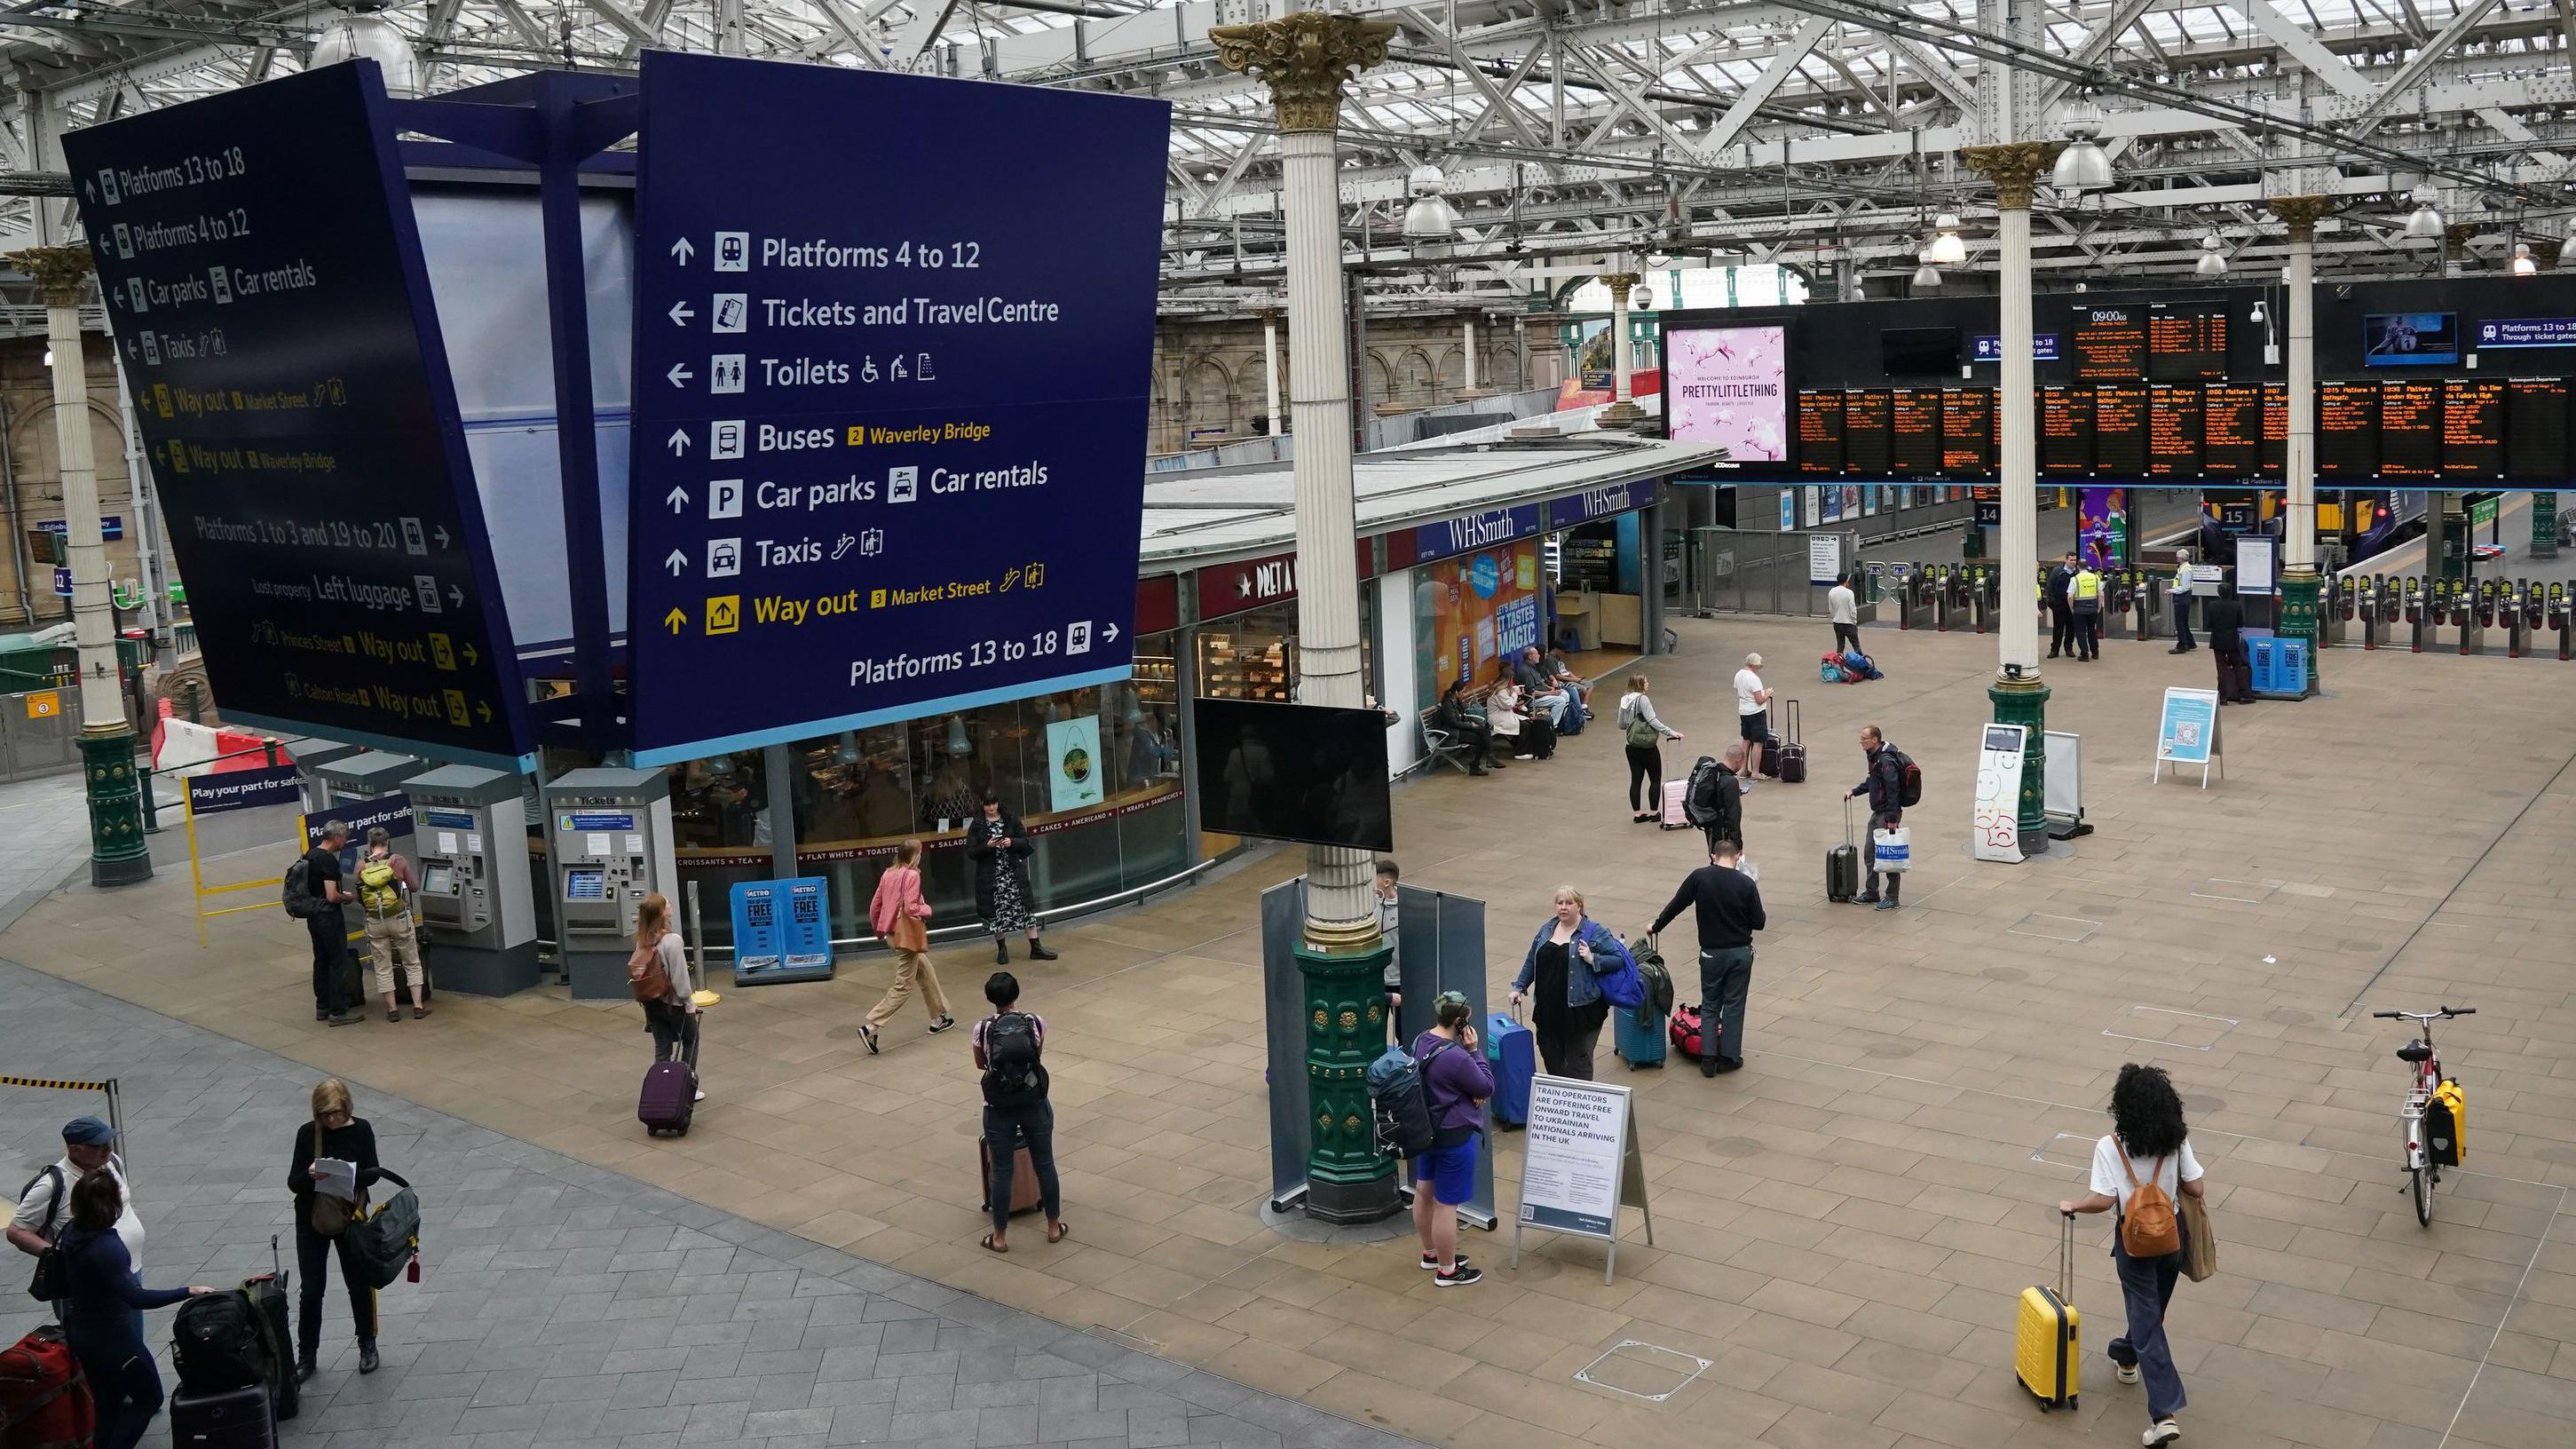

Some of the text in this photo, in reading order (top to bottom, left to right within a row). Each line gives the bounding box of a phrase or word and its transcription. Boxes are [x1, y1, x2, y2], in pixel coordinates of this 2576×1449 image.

[120, 146, 244, 195] Platforms 13 to 18
[134, 209, 249, 250] Platforms 4 to 12
[763, 238, 979, 267] Platforms 4 to 12
[149, 258, 315, 308] Car parks Car rentals
[763, 297, 1058, 326] Tickets and Travel Centre
[2092, 311, 2119, 321] 09:00
[161, 334, 195, 358] Taxis
[761, 358, 849, 385] Toilets
[174, 388, 203, 418] Way
[205, 389, 229, 412] out
[245, 397, 277, 410] Market
[277, 392, 309, 409] Street
[1682, 384, 1777, 398] PRETTYLITTLETHING
[760, 423, 990, 450] Buses 2 Waverley Bridge
[188, 445, 218, 474] Way
[219, 447, 243, 469] out
[260, 453, 302, 472] Waverley
[303, 452, 336, 472] Bridge
[719, 461, 1047, 511] P Car parks Car rentals
[1583, 484, 1630, 519] WHSmith
[1981, 508, 1997, 520] 14
[2225, 511, 2243, 523] 15
[194, 515, 397, 550] Platforms 1 to 3 and 19 to 20
[1449, 508, 1514, 551] WHSmith
[756, 537, 821, 566] Taxis
[55, 574, 64, 588] 12
[1257, 559, 1292, 599] PRET A
[251, 575, 412, 612] Lost property Left luggage
[755, 581, 991, 625] Way out 3 Market Street
[1497, 594, 1535, 615] LET'S JUST AGREE
[1497, 605, 1535, 634] IT TASTES
[281, 630, 313, 650] Princes
[314, 634, 343, 653] Street
[357, 630, 395, 665] Way
[397, 639, 427, 662] out
[1498, 622, 1536, 657] MAGIC
[851, 631, 1056, 685] Platforms 13 to 18
[334, 687, 359, 705] Road
[371, 685, 409, 720] Way
[412, 694, 442, 719] out
[192, 778, 280, 800] Play your part for
[582, 796, 616, 806] Tickets
[1151, 791, 1179, 807] SANDWICHES
[356, 807, 413, 830] part for safe
[1071, 812, 1107, 826] AMERICANO
[1127, 803, 1145, 814] WRAPS
[1040, 823, 1063, 833] CAKES
[807, 850, 855, 861] FLAT WHITE
[748, 904, 772, 917] FREE
[794, 901, 818, 913] FREE
[1536, 1096, 1612, 1114] ARE OFFERING FREE
[1537, 1087, 1608, 1104] TRAIN OPERATORS
[1535, 1105, 1600, 1122] ONWARD TRAVEL
[1546, 1116, 1590, 1129] UKRAINIAN
[1533, 1123, 1616, 1143] NATIONALS ARRIVING
[1541, 1134, 1557, 1144] THE
[1558, 1136, 1570, 1145] UK
